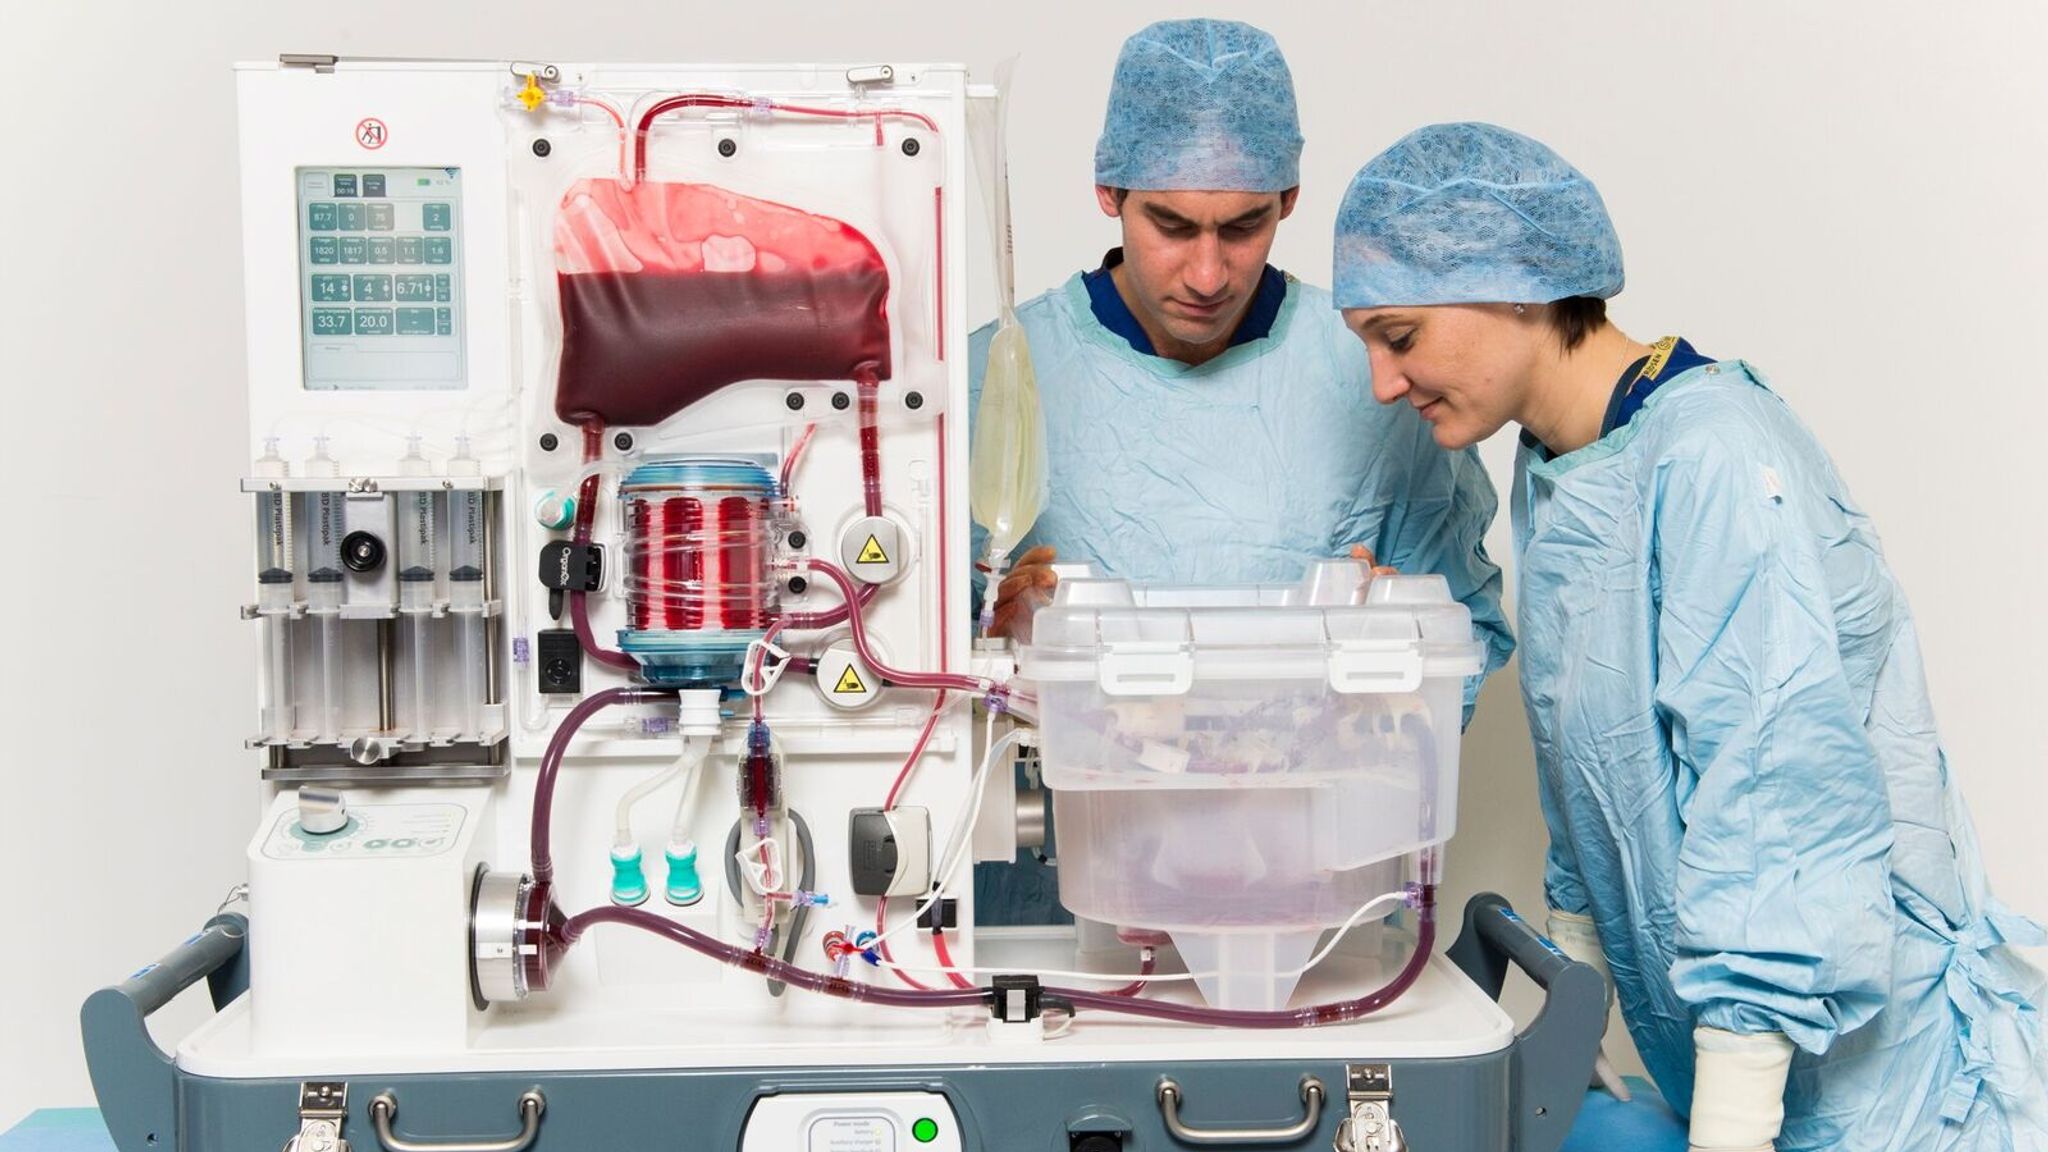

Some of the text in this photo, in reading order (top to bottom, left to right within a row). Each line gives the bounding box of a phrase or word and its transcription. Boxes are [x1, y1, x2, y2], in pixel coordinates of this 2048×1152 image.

[348, 213, 354, 222] 0
[432, 213, 440, 222] 2
[316, 247, 334, 255] 1820
[320, 282, 336, 294] 14
[364, 282, 373, 294] 4
[396, 282, 423, 294] 6.71
[318, 316, 346, 328] 33.7
[360, 316, 388, 328] 20.0
[274, 508, 283, 546] Plastipak
[322, 508, 331, 546] Plastipak
[418, 506, 428, 545] Plastipak
[467, 506, 476, 544] Plastipak
